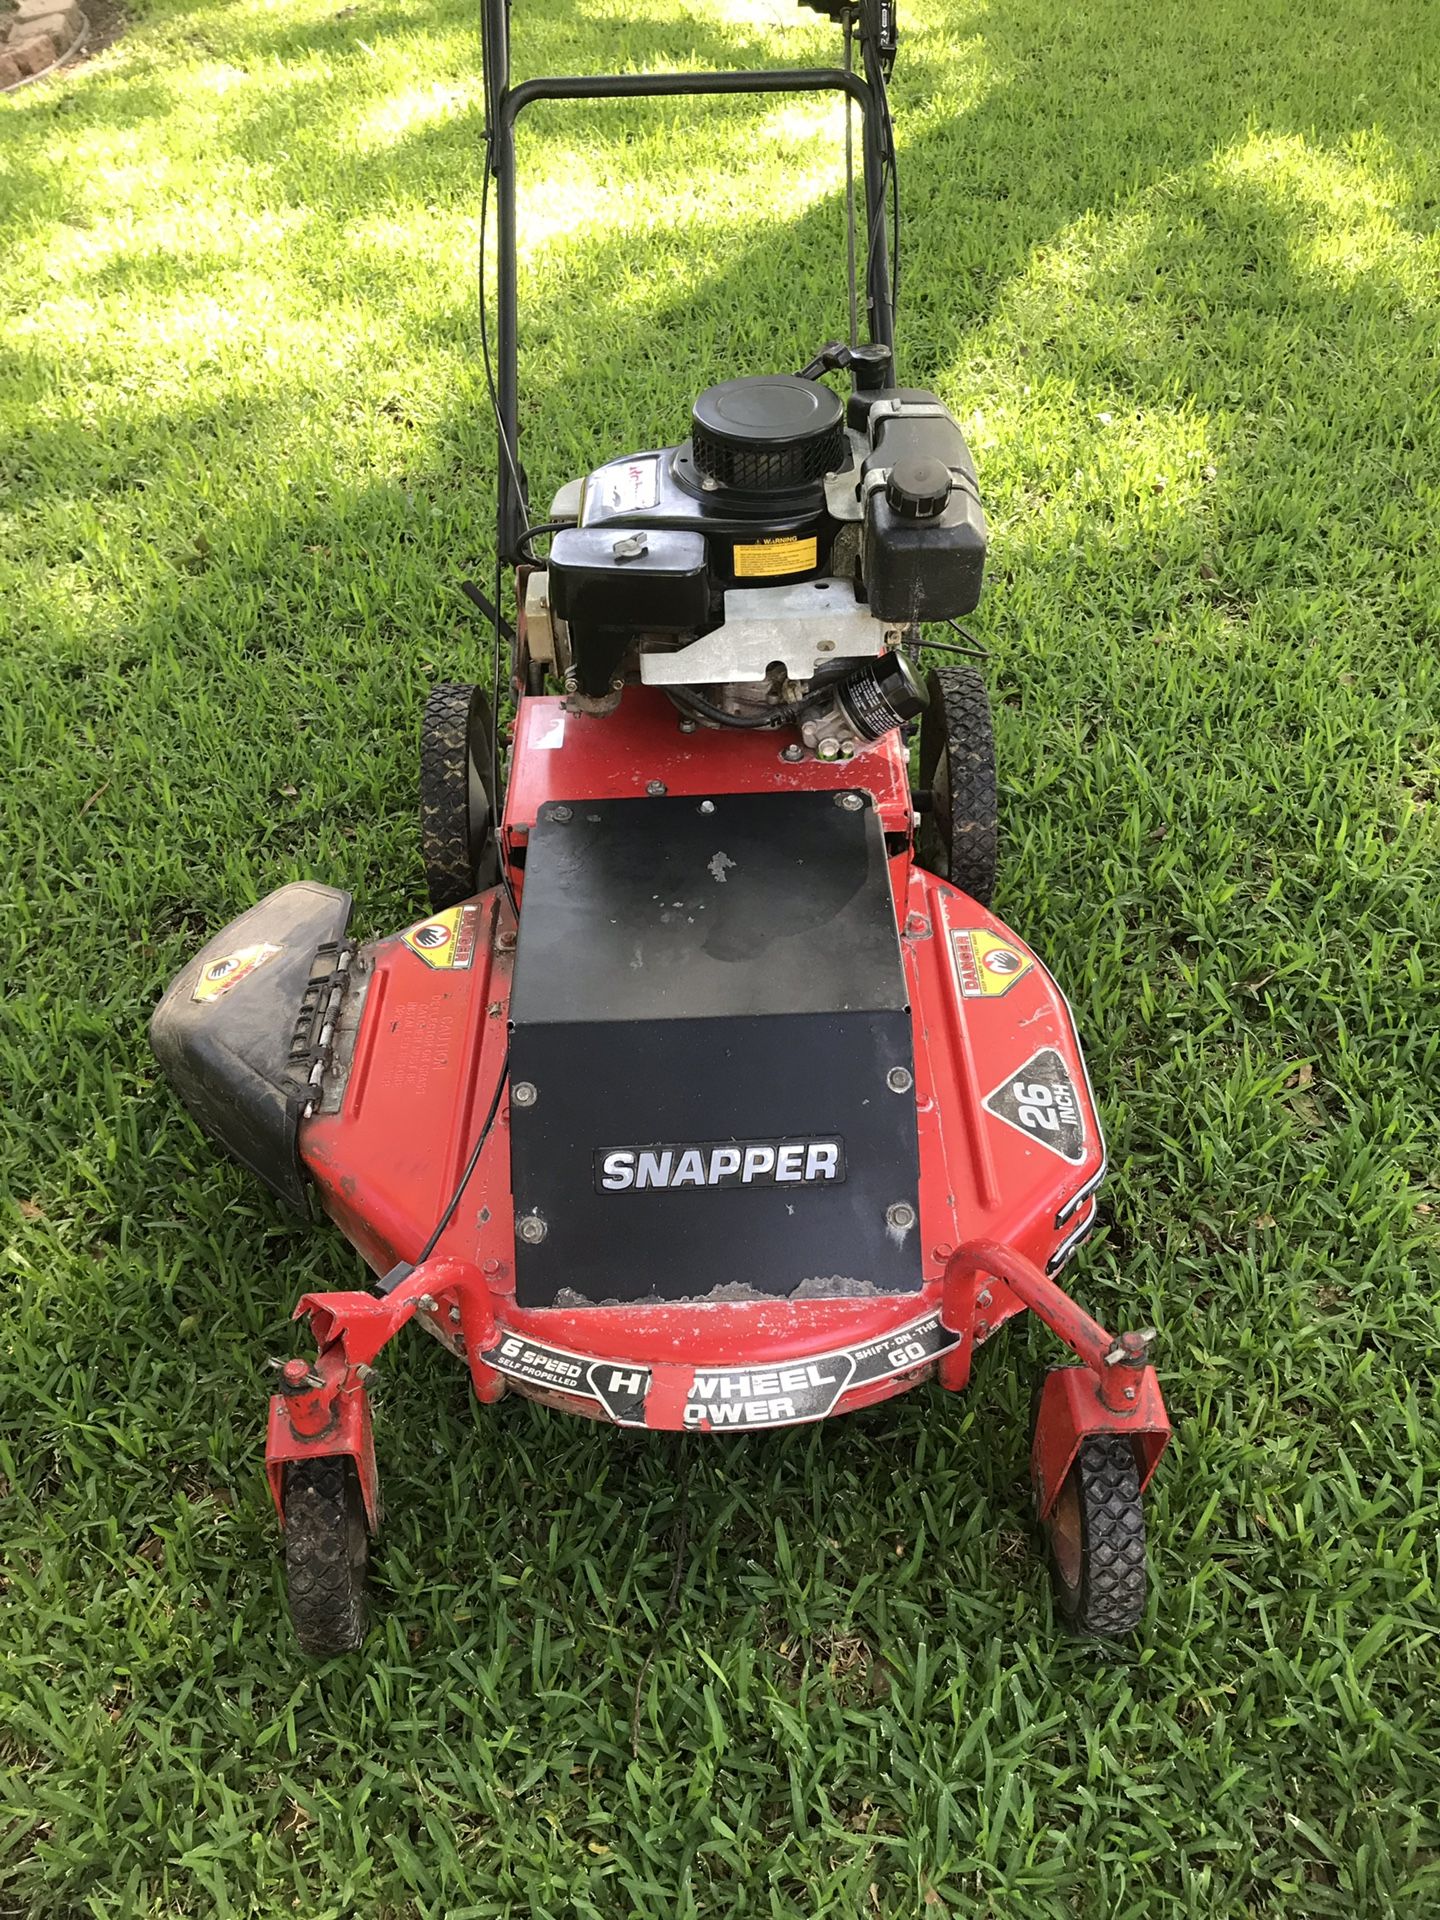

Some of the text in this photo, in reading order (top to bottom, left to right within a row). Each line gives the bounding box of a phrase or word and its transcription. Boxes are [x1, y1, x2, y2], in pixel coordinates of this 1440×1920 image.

[955, 935, 980, 994] DANGER
[432, 1015, 454, 1072] CAUTION
[1013, 1081, 1060, 1131] 26
[1051, 1084, 1078, 1125] INCH
[602, 1143, 838, 1190] SNAPPER
[497, 1356, 578, 1388] SELF PROPELLED
[501, 1338, 582, 1378] 6 SPEED
[887, 1341, 926, 1368] GO
[687, 1365, 836, 1399] WHEEL
[683, 1397, 797, 1424] OWER
